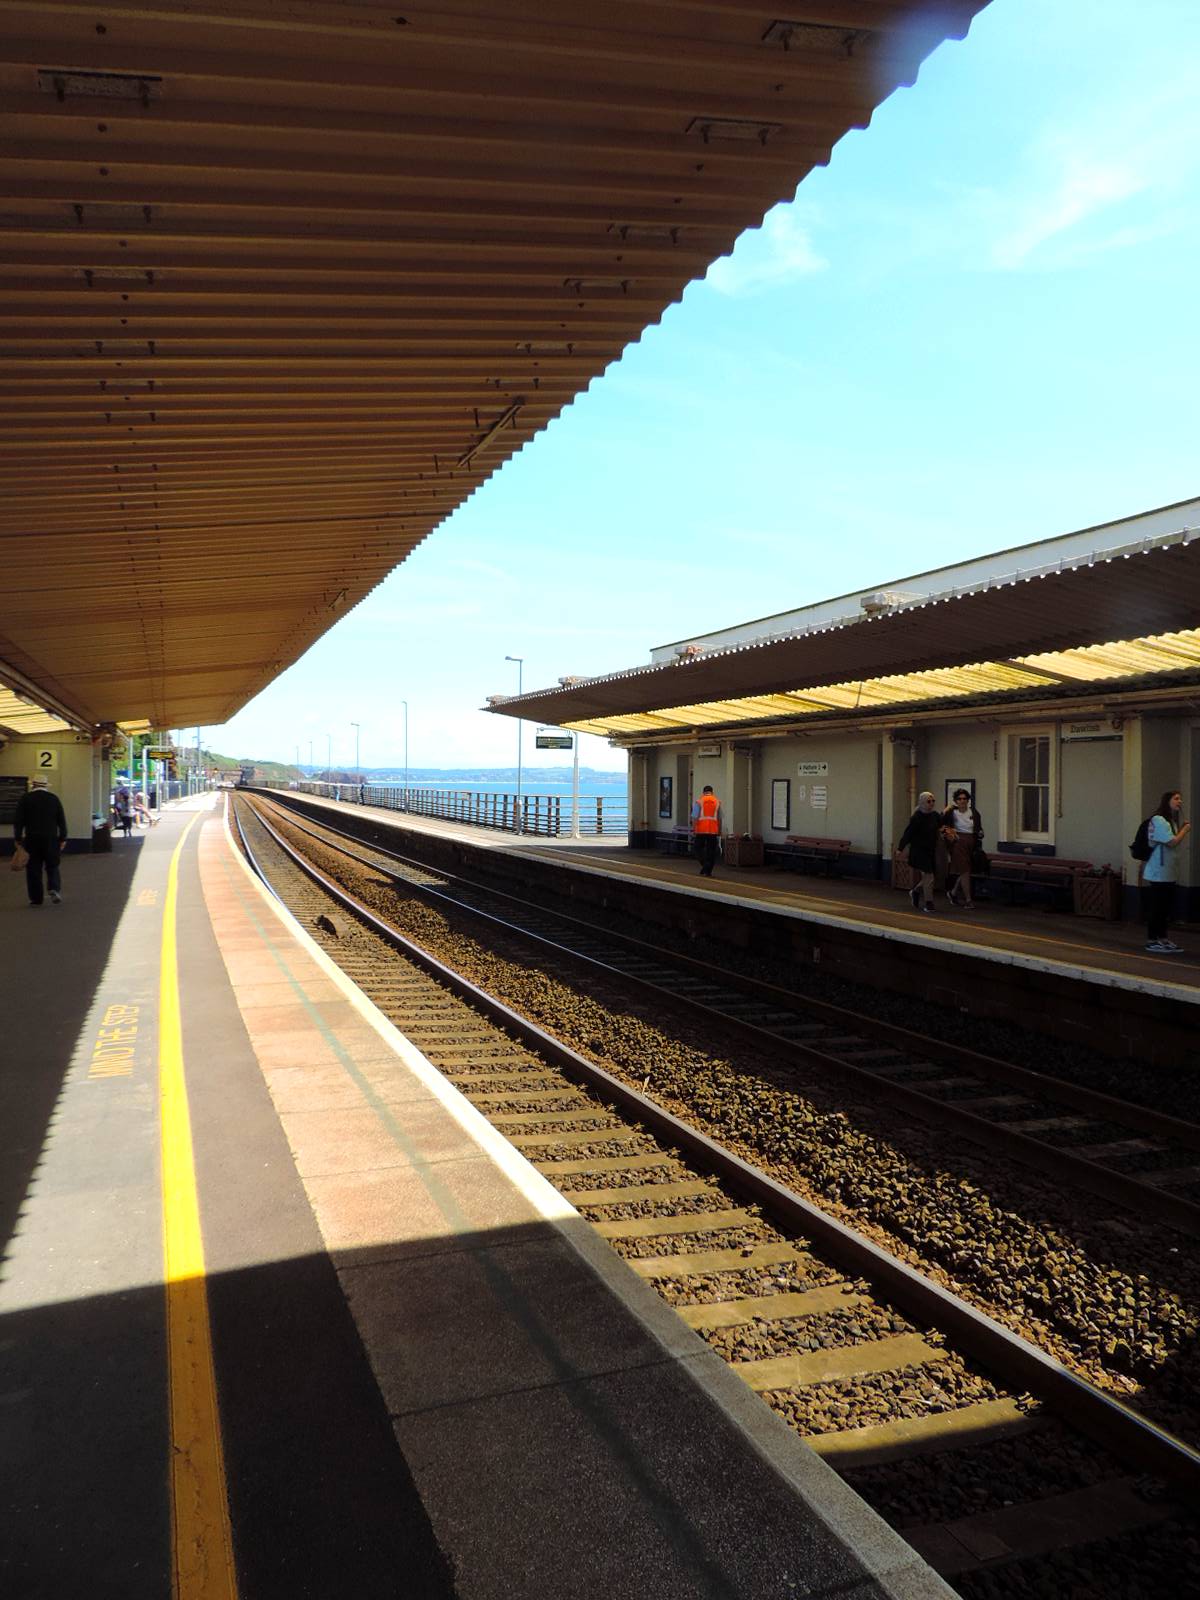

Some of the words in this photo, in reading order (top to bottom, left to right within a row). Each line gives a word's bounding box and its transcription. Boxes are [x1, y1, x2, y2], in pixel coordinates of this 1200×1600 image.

[40, 751, 52, 767] 2
[102, 1004, 139, 1026] STEP
[95, 1026, 138, 1049] THE
[88, 1047, 135, 1078] MIND
